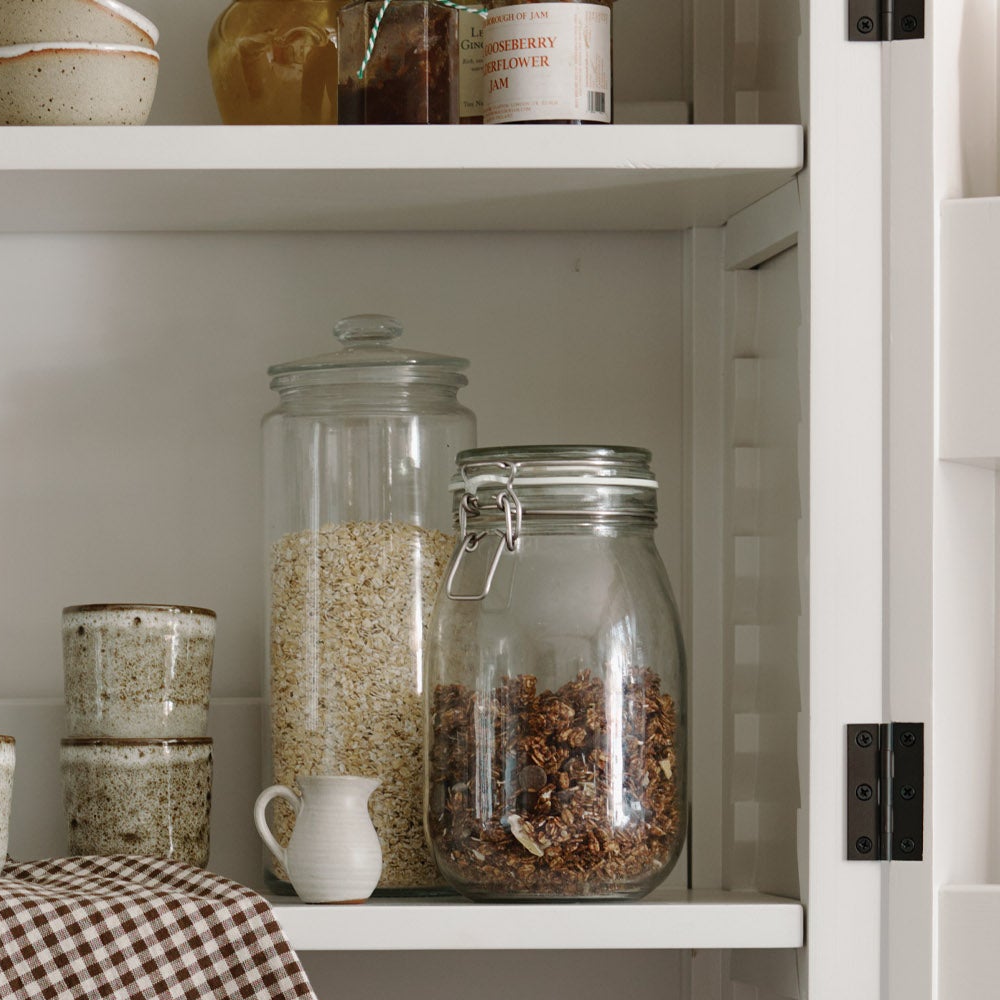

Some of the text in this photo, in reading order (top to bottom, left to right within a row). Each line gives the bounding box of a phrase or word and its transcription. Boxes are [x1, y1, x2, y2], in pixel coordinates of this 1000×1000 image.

[516, 12, 527, 20] OF
[530, 11, 548, 20] JAM
[489, 77, 509, 94] JAM
